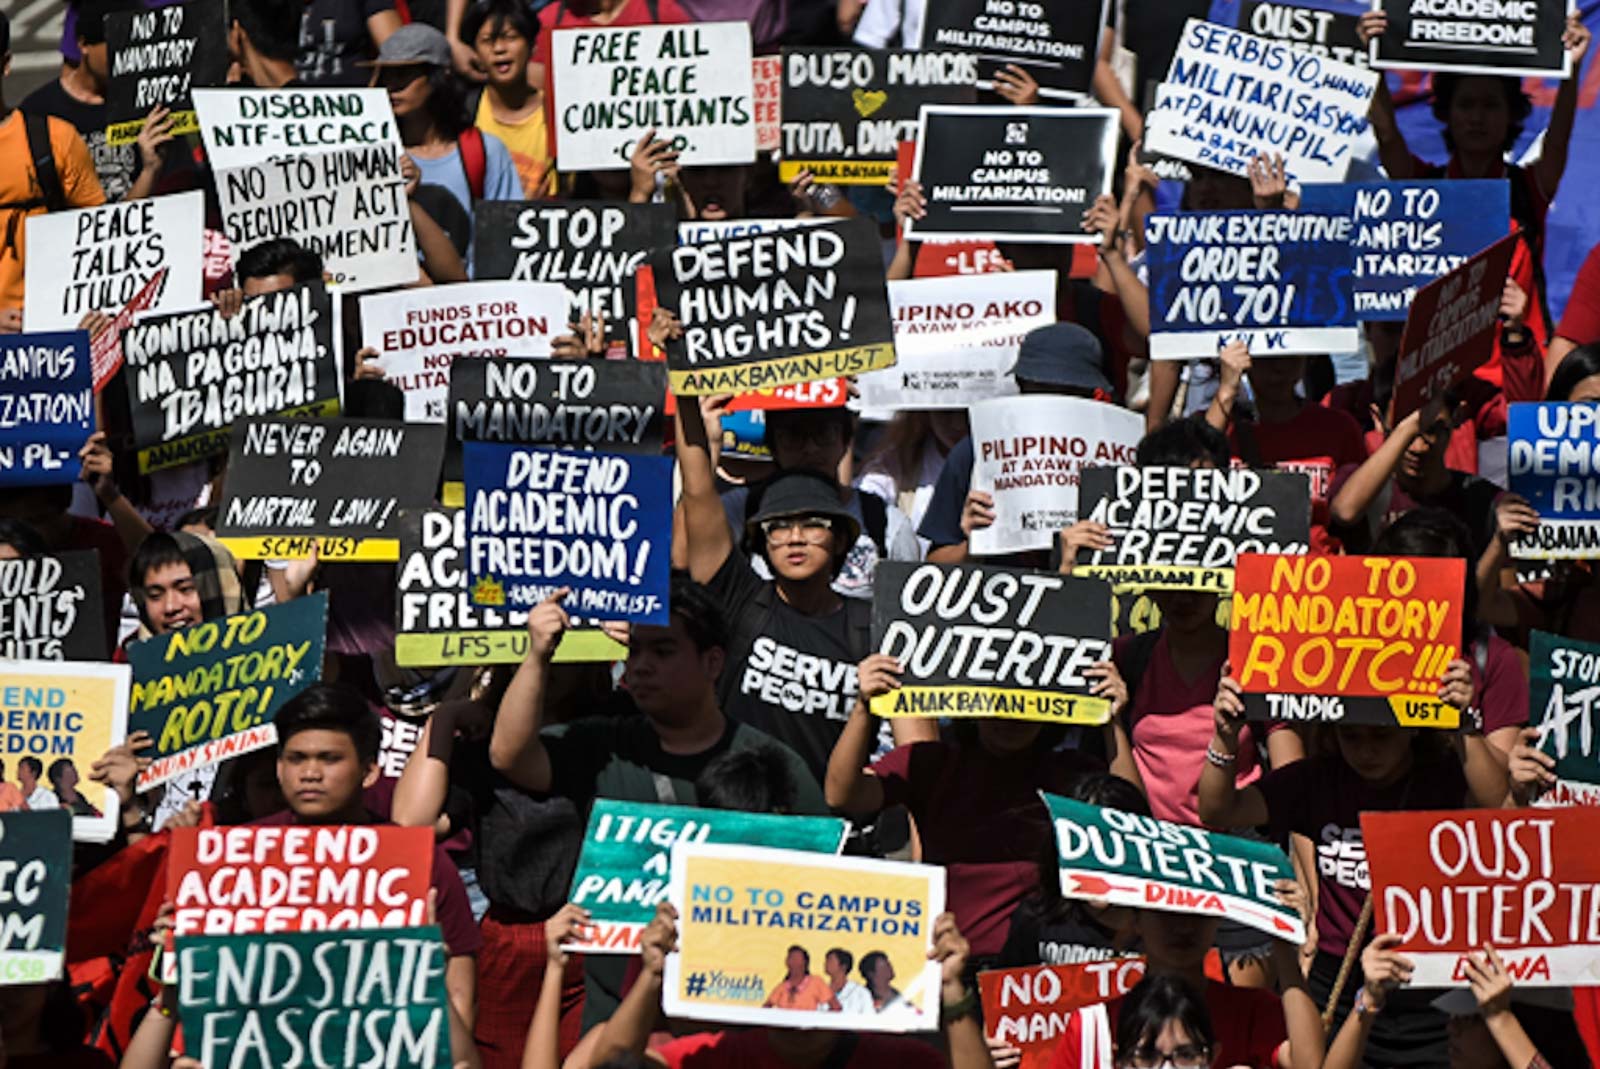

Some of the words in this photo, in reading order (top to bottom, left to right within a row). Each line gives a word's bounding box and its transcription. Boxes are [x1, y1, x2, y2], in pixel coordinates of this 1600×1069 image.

[131, 14, 156, 40] NO
[162, 6, 184, 32] TO
[974, 17, 1050, 38] CAMPUS
[986, 0, 1011, 15] NO
[1020, 3, 1043, 18] TO
[1252, 3, 1335, 42] OUST
[572, 32, 642, 65] FREE
[658, 28, 709, 59] ALL
[936, 29, 1084, 59] MILITARIZATION!
[1411, 22, 1535, 46] FREEDOM!
[112, 37, 197, 77] MANDATORY
[788, 53, 875, 88] DU30
[888, 51, 979, 86] MARCOS
[1187, 24, 1322, 90] SERBISYO,
[135, 73, 191, 108] ROTC!
[611, 65, 697, 96] PEACE
[240, 94, 364, 119] DISBAND
[564, 96, 751, 133] CONSULTANTS
[228, 166, 265, 205] NO
[276, 157, 316, 192] TO
[323, 143, 398, 183] HUMAN
[972, 168, 1050, 184] CAMPUS
[983, 151, 1011, 166] NO
[1017, 150, 1044, 166] TO
[227, 193, 339, 243] SECURITY
[353, 182, 401, 219] ACT
[932, 185, 1086, 203] MILITARIZATION!
[1355, 188, 1390, 219] NO
[1401, 187, 1440, 219] TO
[76, 202, 155, 246] PEACE
[510, 207, 626, 249] STOP
[1146, 215, 1222, 244] JUNK
[1226, 213, 1352, 243] EXECUTIVE
[1351, 220, 1443, 251] AMPUS
[73, 233, 165, 280] TALKS
[671, 230, 845, 282] DEFEND
[1181, 246, 1280, 283] ORDER
[406, 305, 471, 326] FUNDS
[477, 300, 518, 318] FOR
[679, 269, 837, 325] HUMAN
[984, 299, 1043, 319] AKO
[124, 286, 319, 366] KONTRAKTWAL
[383, 315, 549, 352] EDUCATION
[685, 295, 858, 364] RIGHTS!
[138, 358, 178, 403] NA
[485, 362, 538, 401] NO
[550, 363, 597, 401] TO
[682, 348, 880, 391] ANAKBAYAN-UST
[161, 364, 317, 441] IBASURA!
[243, 424, 325, 457] NEVER
[333, 428, 403, 459] AGAIN
[455, 401, 655, 444] MANDATORY
[982, 435, 1088, 463] PILIPINO
[1001, 460, 1016, 475] AT
[1022, 458, 1071, 471] AYAW
[290, 459, 321, 486] TO
[506, 452, 630, 495] DEFEND
[1116, 466, 1261, 501] DEFEND
[225, 497, 320, 528] MARTIAL
[329, 499, 398, 530] LAW!
[470, 488, 639, 540] ACADEMIC
[1086, 496, 1276, 538] ACADEMIC
[471, 537, 650, 585] FREEDOM!
[1270, 556, 1332, 594] NO
[1362, 557, 1417, 597] TO
[901, 565, 1064, 628] OUST
[1232, 591, 1451, 640] MANDATORY
[164, 622, 220, 663] NO
[220, 610, 267, 650] TO
[129, 640, 312, 715] MANDATORY
[748, 636, 860, 696] SERVE
[1240, 637, 1458, 695] ROTC!!!
[157, 685, 275, 754] ROTC!
[893, 690, 1079, 719] ANAKBAYAN-UST
[1265, 694, 1345, 721] TINDIG
[1406, 700, 1442, 720] UST
[196, 827, 379, 864] DEFEND
[1100, 806, 1210, 850] OUST
[1055, 817, 1281, 903] DUTERTE
[1429, 819, 1556, 881] OUST
[176, 867, 410, 906] ACADEMIC
[690, 884, 735, 905] NO
[746, 888, 785, 908] TO
[796, 891, 923, 918] CAMPUS
[691, 906, 921, 937] MILITARIZATION
[177, 941, 305, 1009] END
[306, 937, 447, 1009] STATE
[1000, 968, 1062, 1009] NO
[200, 1007, 443, 1069] FASCISM
